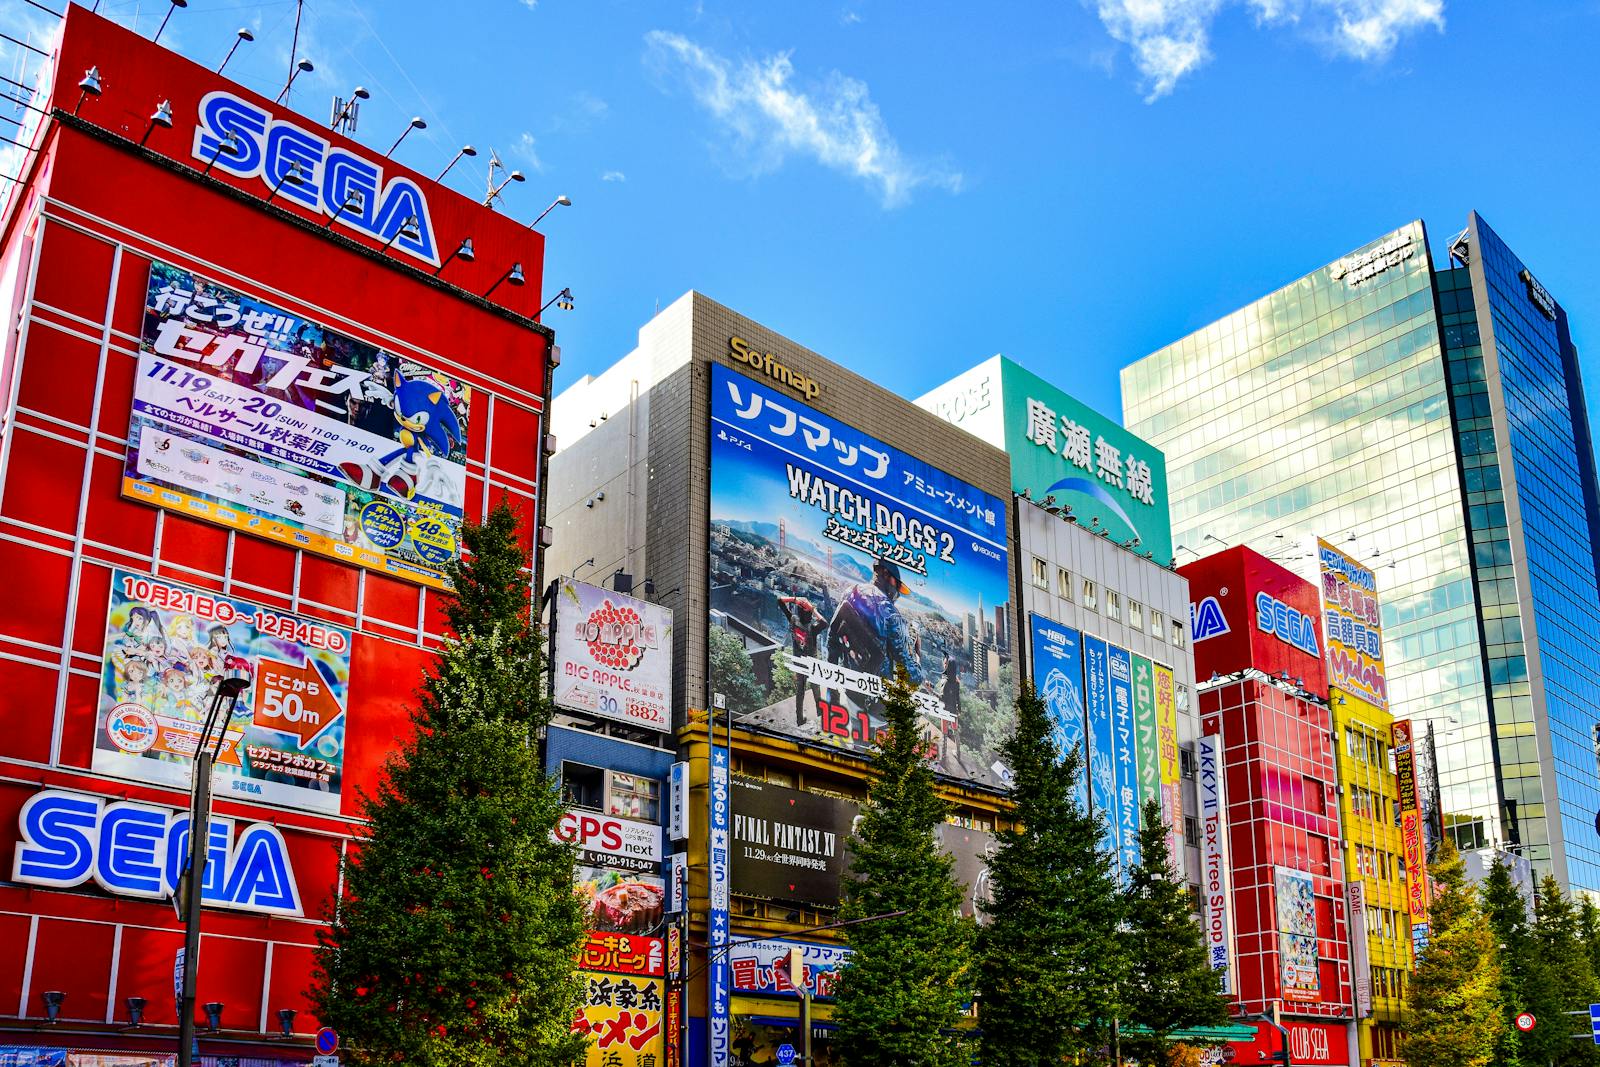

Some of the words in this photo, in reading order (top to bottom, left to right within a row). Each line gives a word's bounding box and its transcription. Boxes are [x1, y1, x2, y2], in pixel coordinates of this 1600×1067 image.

[192, 91, 441, 267] SEGA
[731, 336, 820, 400] Sofmap
[176, 396, 331, 459] ベルサール秋葉原
[727, 381, 890, 479] ソフマップ
[729, 437, 753, 452] PS4
[1025, 397, 1155, 506] 廣瀬無線
[903, 470, 996, 528] アミューズメント館
[416, 521, 441, 535] 48
[1256, 591, 1320, 659] SEGA
[1326, 610, 1382, 661] 高額買取
[264, 672, 320, 695] ここから
[565, 661, 590, 682] BIG
[262, 687, 321, 725] 50m
[113, 719, 153, 734] Aqours
[246, 744, 337, 776] セガコラボカフェ
[1200, 741, 1217, 796] AKKY
[232, 780, 262, 794] SEGA
[554, 813, 622, 851] GPS
[734, 814, 770, 846] FINAL
[823, 831, 836, 858] XV
[12, 790, 304, 918] SEGA
[597, 856, 653, 872] 0120-915-047
[625, 845, 653, 859] next
[1206, 812, 1222, 892] Tax-free
[1210, 894, 1224, 944] Shop
[1351, 886, 1361, 916] GAME
[1519, 1017, 1531, 1027] 50
[778, 1049, 795, 1059] 437
[1291, 1026, 1310, 1060] CLUB
[1310, 1027, 1330, 1061] SEGA
